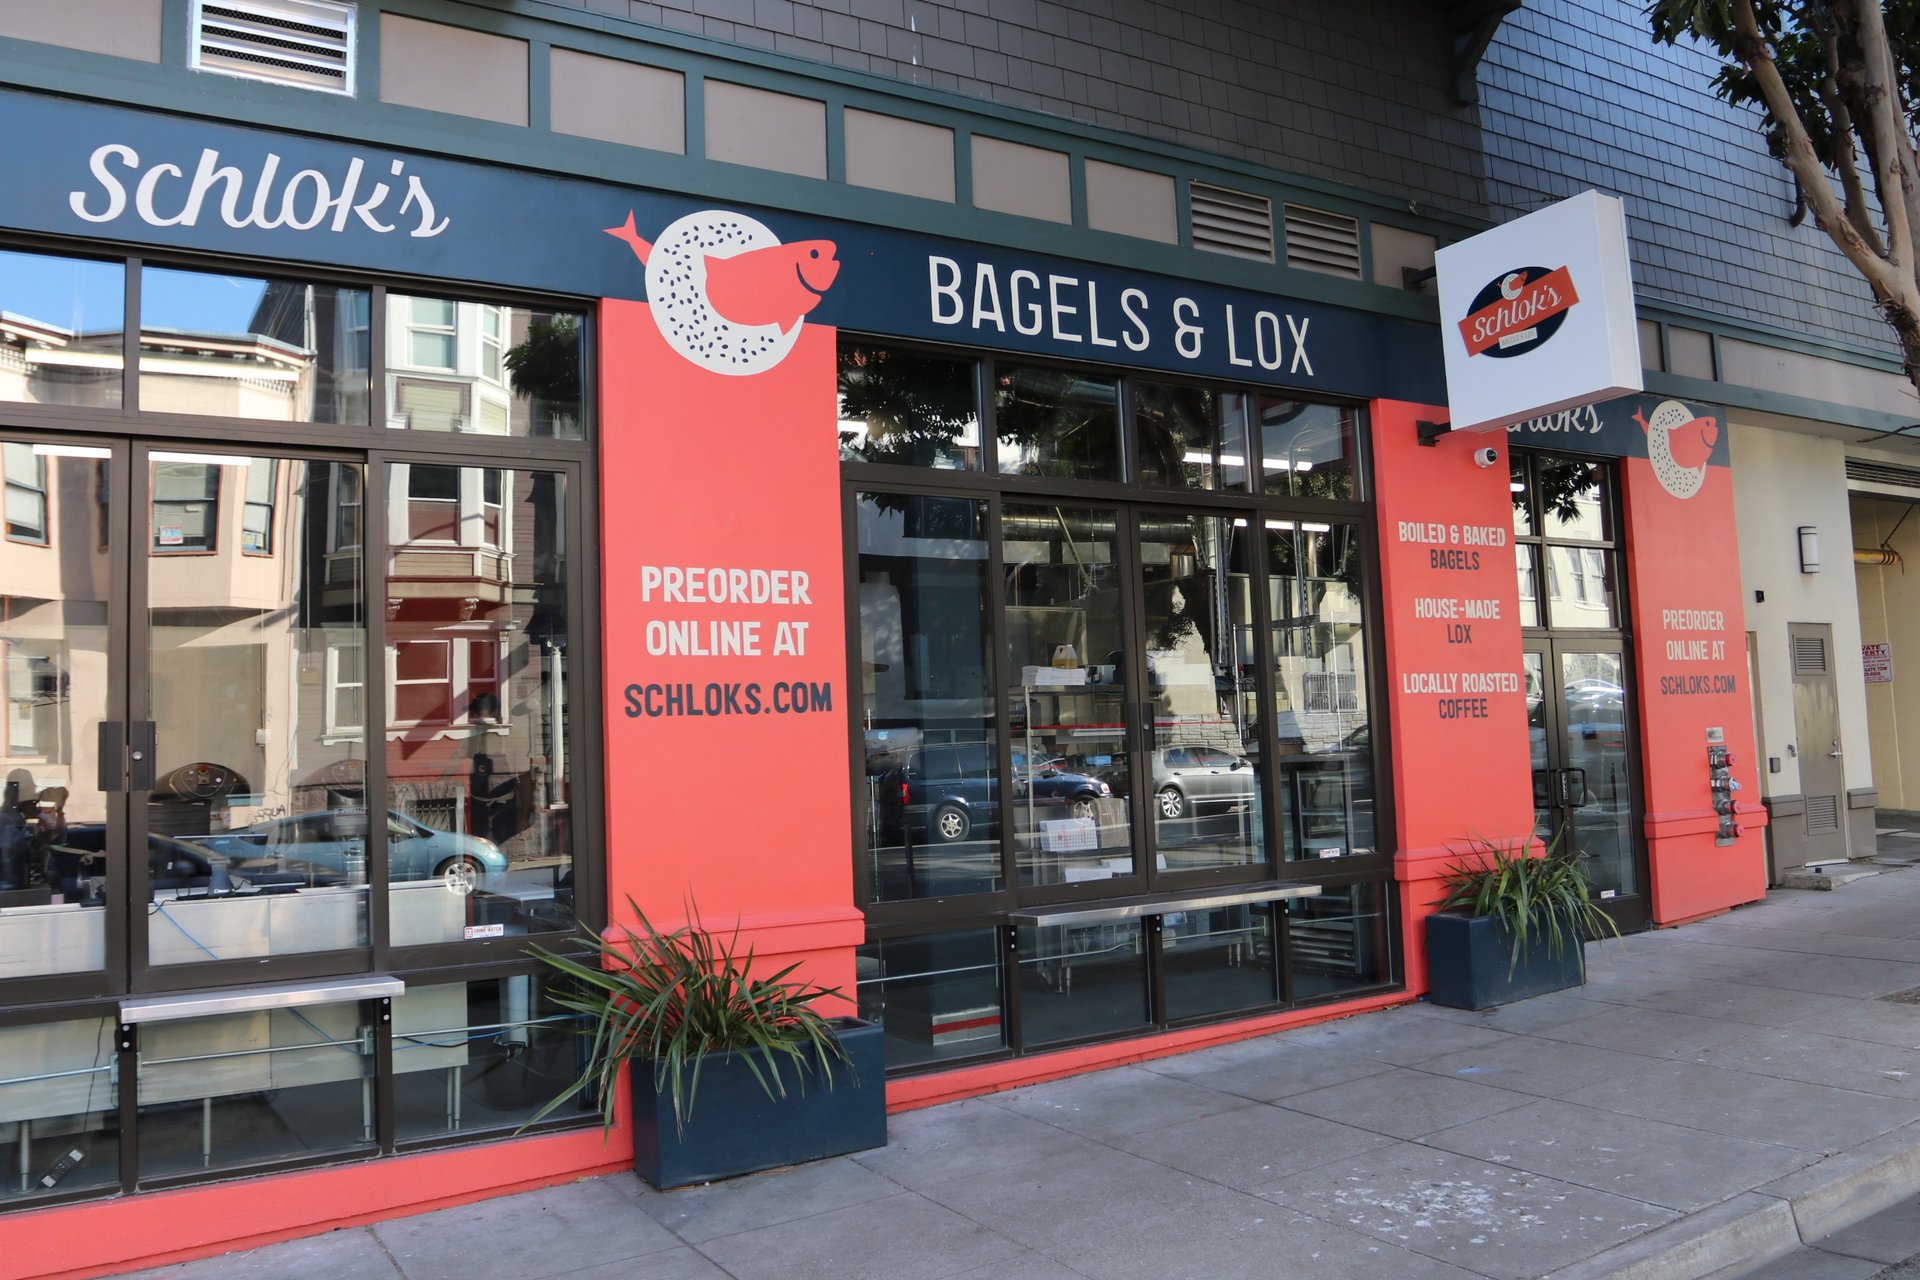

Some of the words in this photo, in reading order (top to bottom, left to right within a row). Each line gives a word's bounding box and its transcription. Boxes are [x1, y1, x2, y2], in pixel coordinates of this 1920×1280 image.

[69, 143, 450, 238] Schlok's
[928, 255, 1150, 351] BAGELS
[1173, 297, 1204, 359] &
[1226, 304, 1314, 376] LOX
[1473, 285, 1562, 343] Schlok's
[1398, 521, 1446, 544] BOILED
[1450, 525, 1459, 544] &
[1463, 525, 1506, 546] BAKED
[1430, 549, 1480, 570] BAGELS
[641, 566, 813, 605] PREORDER
[1415, 598, 1500, 619] HOUSE-MADE
[1662, 609, 1725, 631] PREORDER
[646, 620, 761, 656] ONLINE
[772, 621, 809, 656] AT
[1447, 624, 1472, 644] LOX
[1666, 640, 1709, 660] ONLINE
[1712, 640, 1725, 660] AT
[1403, 673, 1458, 693] LOCALLY
[1462, 673, 1518, 693] ROASTED
[1661, 675, 1736, 695] SCHLOKS.COM
[624, 682, 832, 718] SCHLOKS.COM
[1439, 698, 1488, 719] COFFEE
